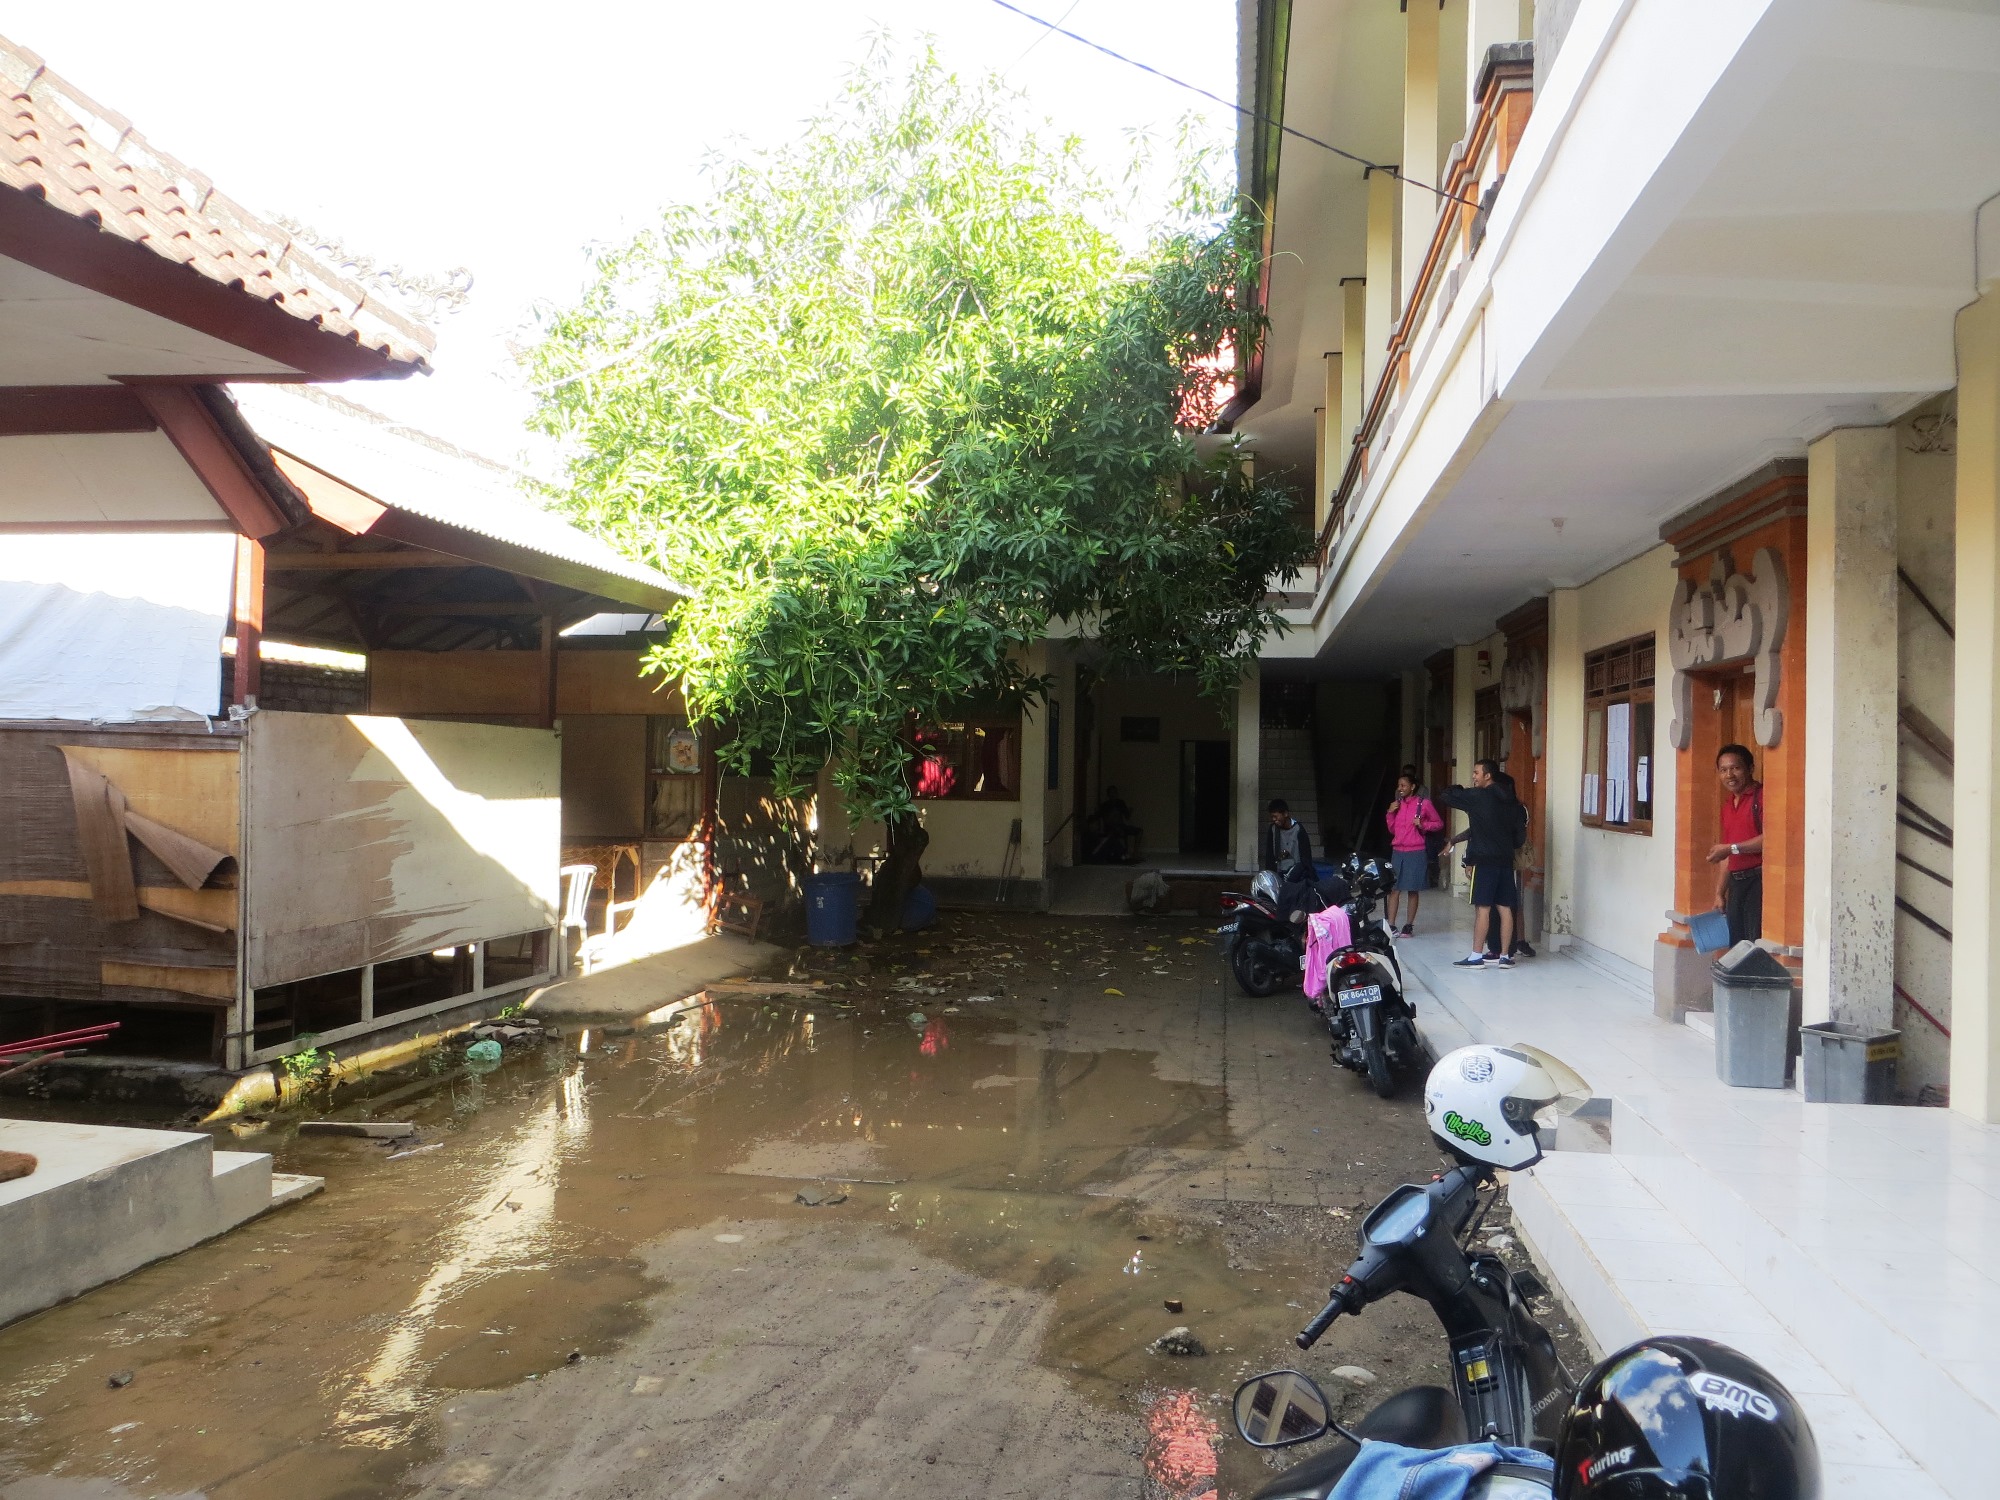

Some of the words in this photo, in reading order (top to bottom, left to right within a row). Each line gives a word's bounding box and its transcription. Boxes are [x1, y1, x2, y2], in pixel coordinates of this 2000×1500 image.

[1340, 992, 1349, 1001] DK
[1530, 1387, 1562, 1415] HONDA
[1700, 1377, 1771, 1416] BMC
[1578, 1447, 1634, 1486] Touring
